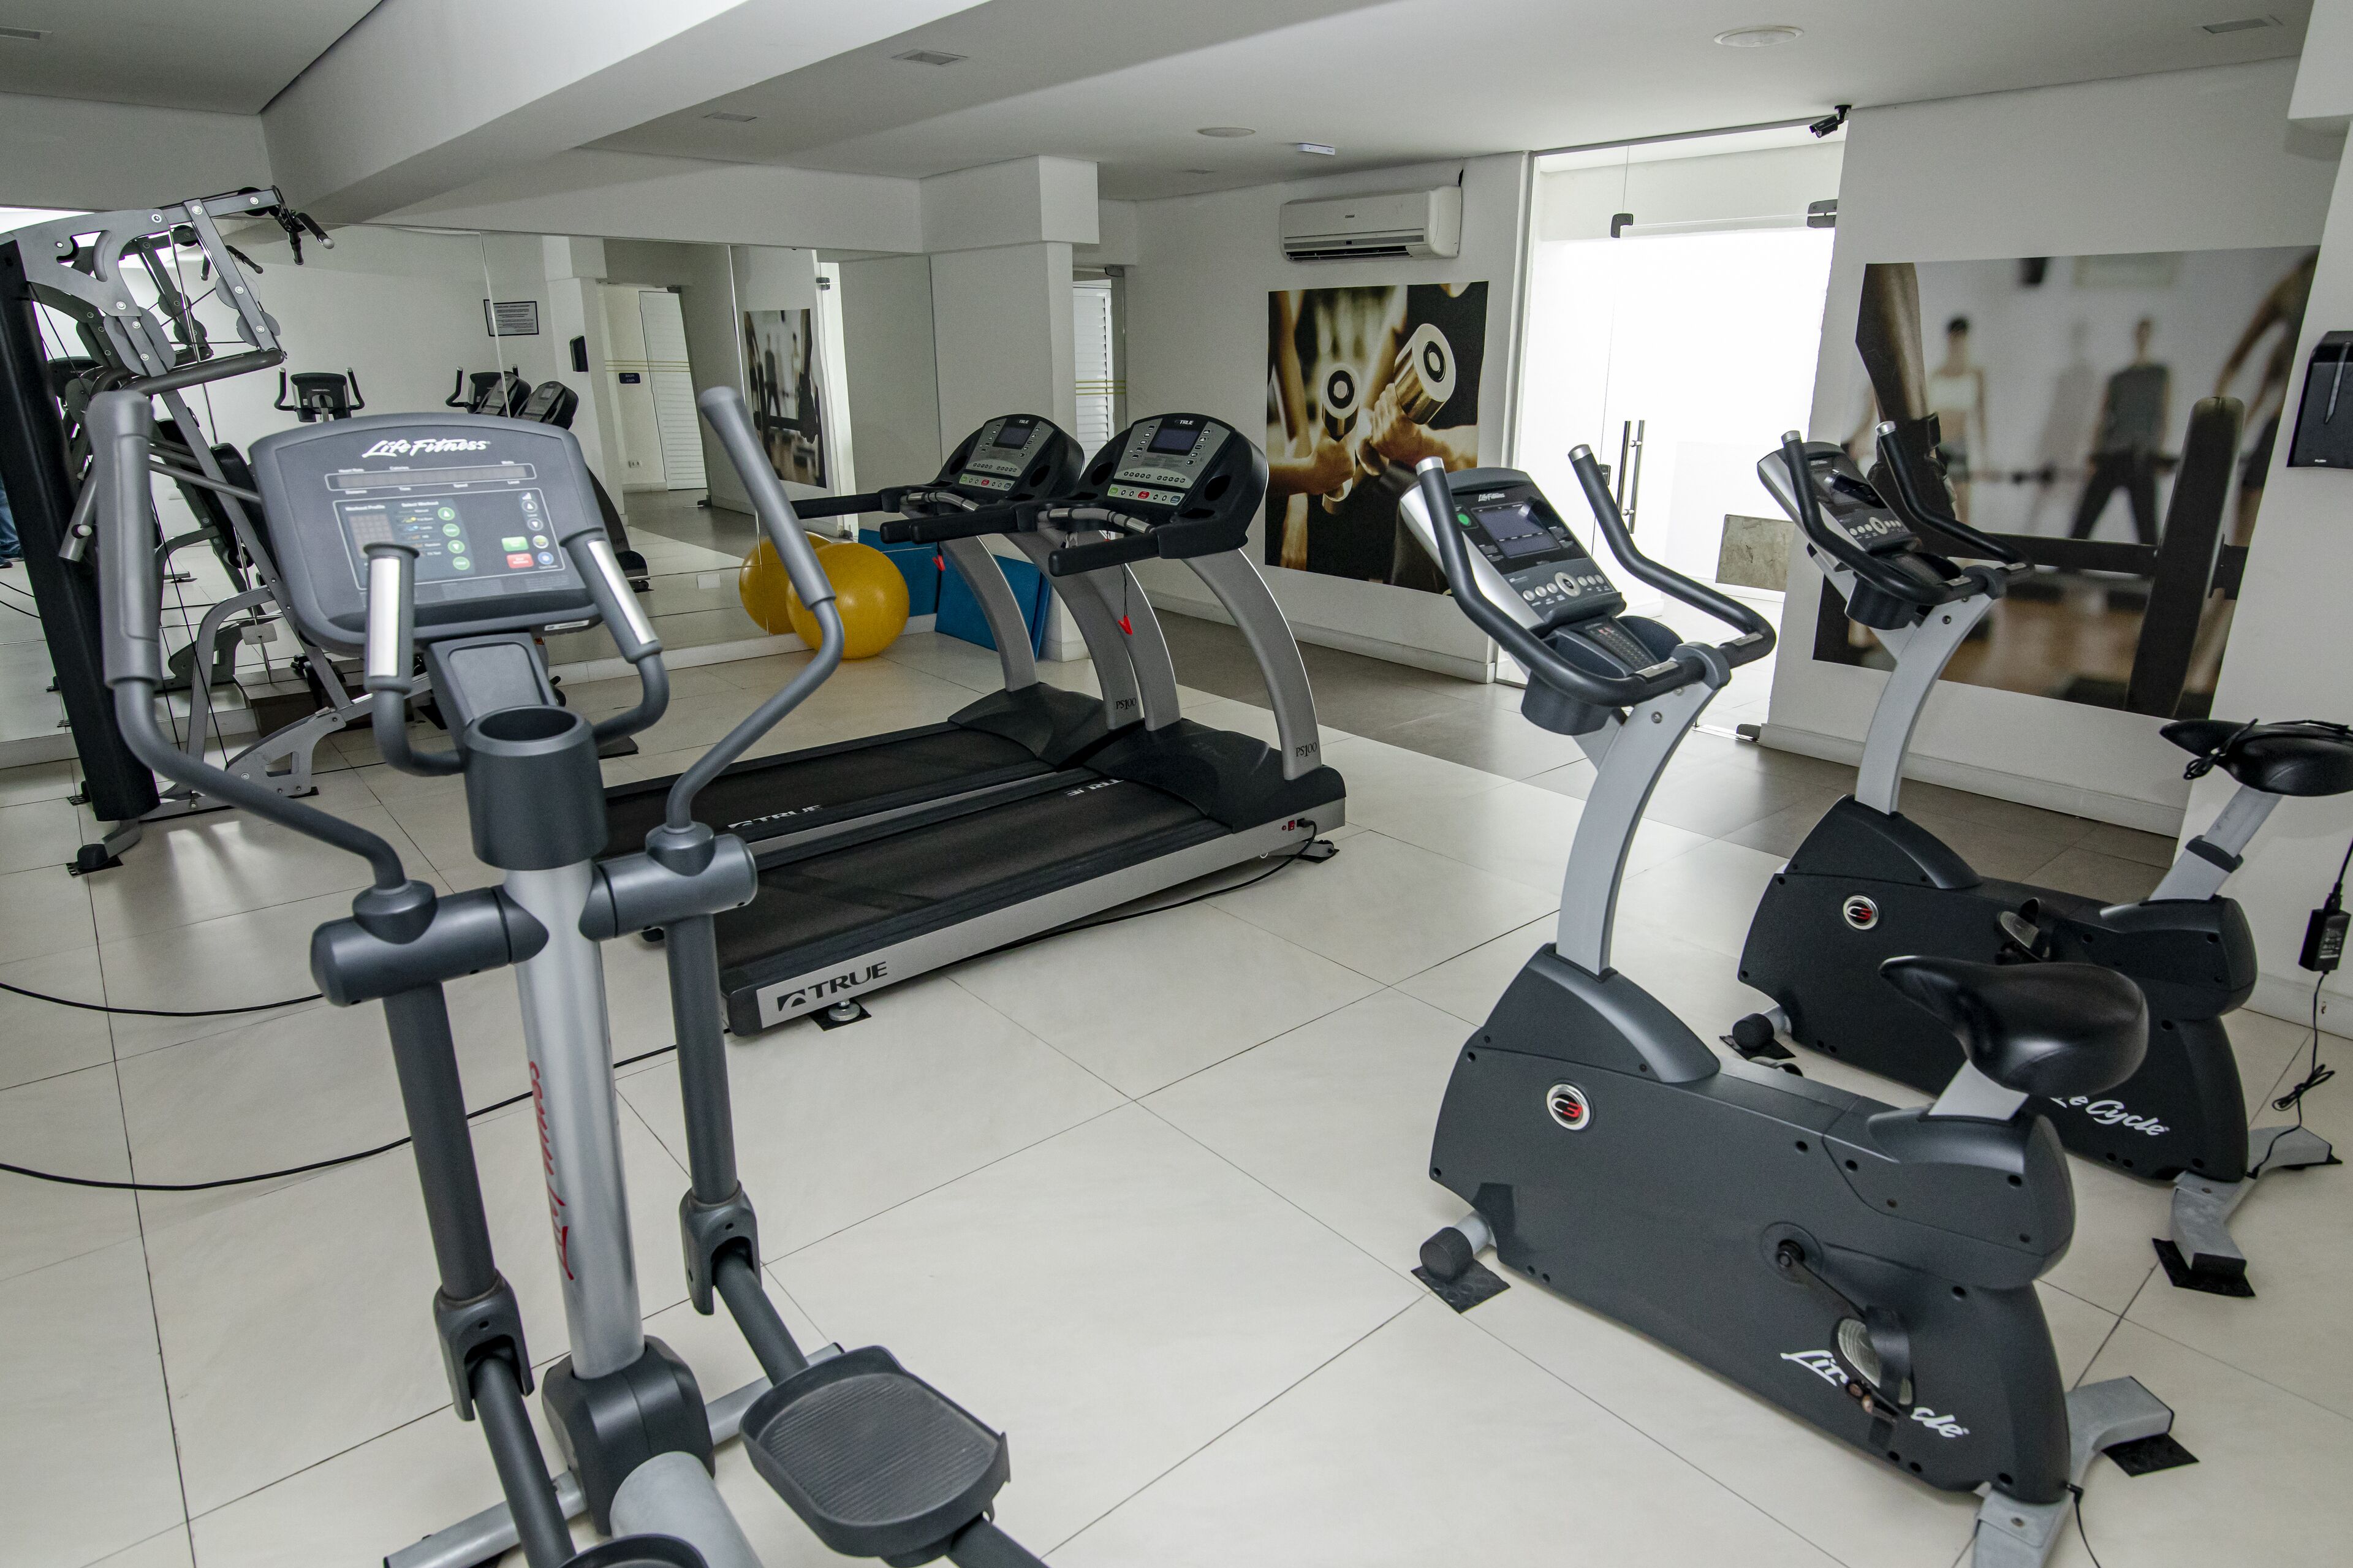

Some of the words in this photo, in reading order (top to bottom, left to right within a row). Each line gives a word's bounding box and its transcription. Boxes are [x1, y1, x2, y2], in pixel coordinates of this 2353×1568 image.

[1116, 697, 1137, 710] PS100
[1296, 742, 1317, 757] PS100
[808, 961, 887, 999] TRUE
